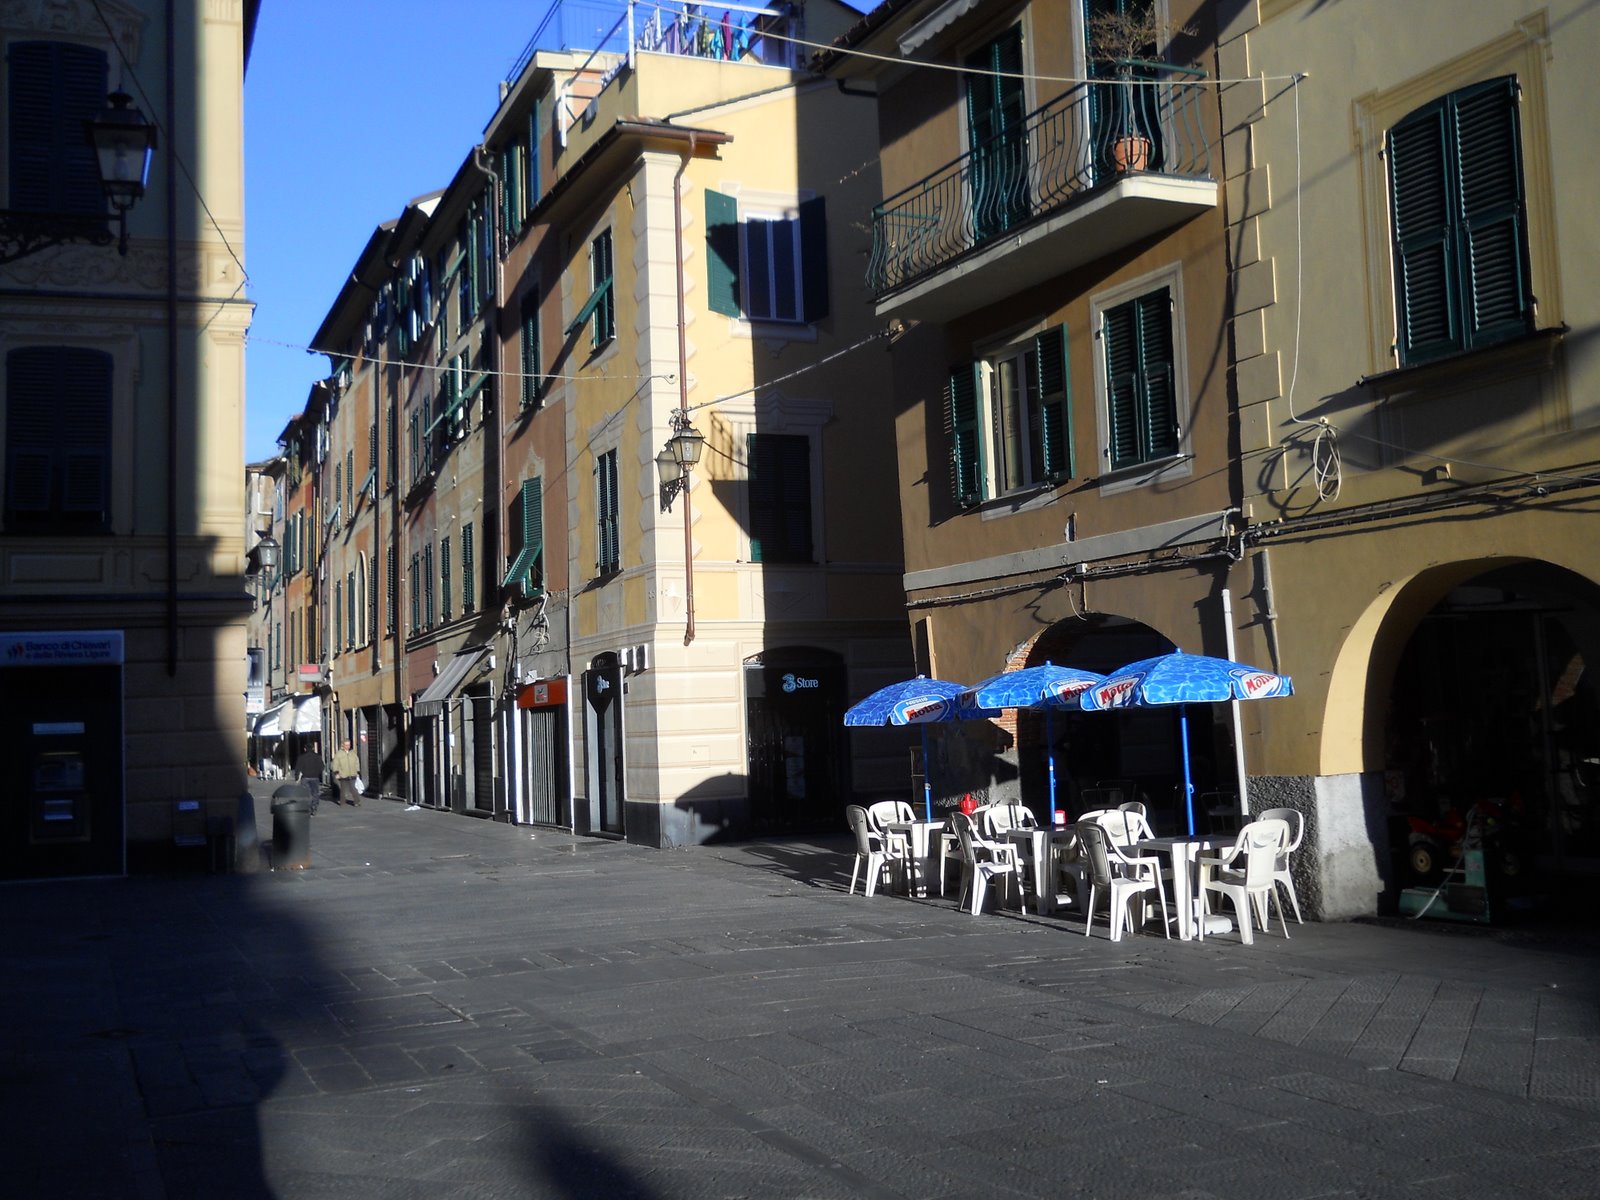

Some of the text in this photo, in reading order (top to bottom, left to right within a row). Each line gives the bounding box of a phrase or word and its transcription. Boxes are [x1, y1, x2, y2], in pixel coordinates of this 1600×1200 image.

[26, 639, 111, 650] Banco di Chiavari
[781, 672, 819, 693] 3 Store
[1100, 681, 1134, 705] Motta
[905, 702, 943, 721] Motta
